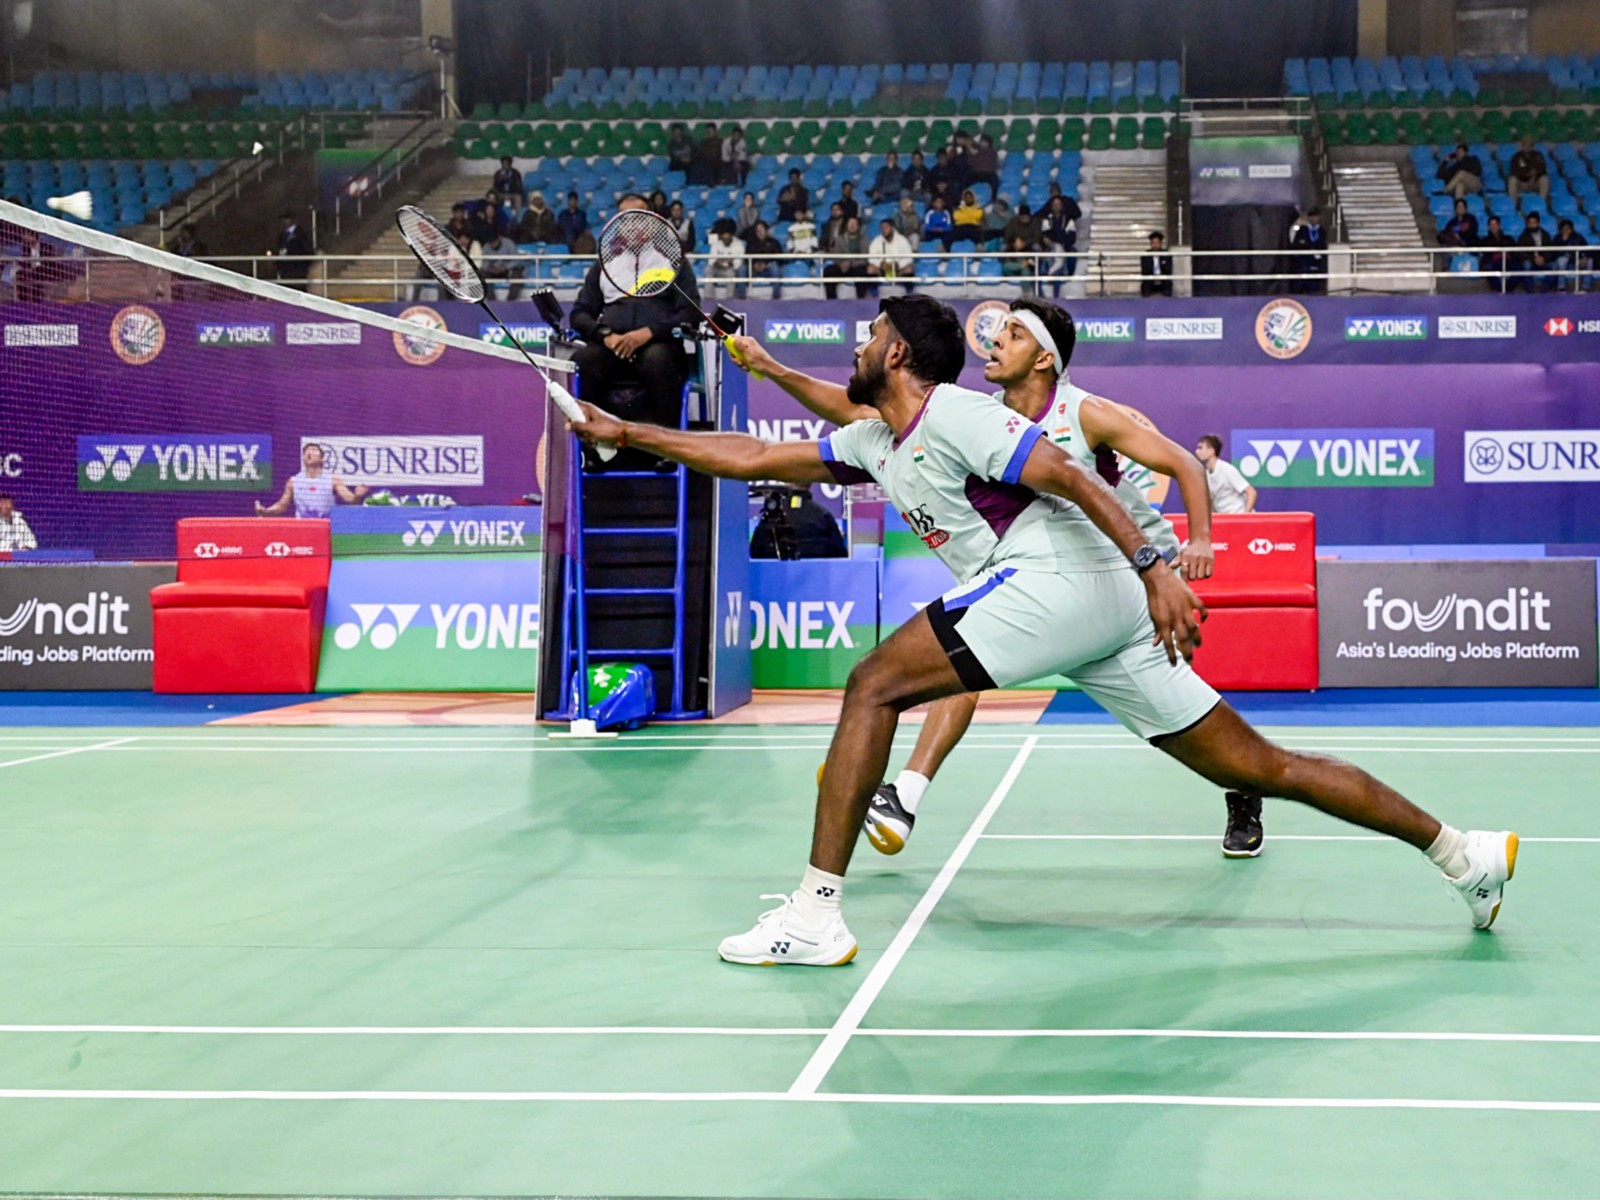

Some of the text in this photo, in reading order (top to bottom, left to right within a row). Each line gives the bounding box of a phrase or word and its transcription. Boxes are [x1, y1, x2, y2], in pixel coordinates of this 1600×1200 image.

[227, 326, 270, 342] YONEX
[796, 324, 841, 339] YONEX
[1085, 322, 1130, 338] YONEX
[1163, 323, 1219, 335] SUNRISE
[1376, 320, 1422, 336] YONEX
[1456, 321, 1513, 333] SUNRISE
[152, 444, 260, 481] YONEX
[342, 446, 479, 475] SUNRISE
[1309, 438, 1420, 477] YONEX
[1507, 441, 1600, 471] SUNR
[449, 520, 525, 546] YONEX
[1211, 542, 1229, 551] SBC
[1274, 543, 1296, 551] HSBC
[1363, 587, 1551, 632] foundit
[36, 646, 79, 662] Jobs
[82, 645, 154, 662] Platform
[1336, 642, 1579, 662] Asia's Leading Jobs Platform
